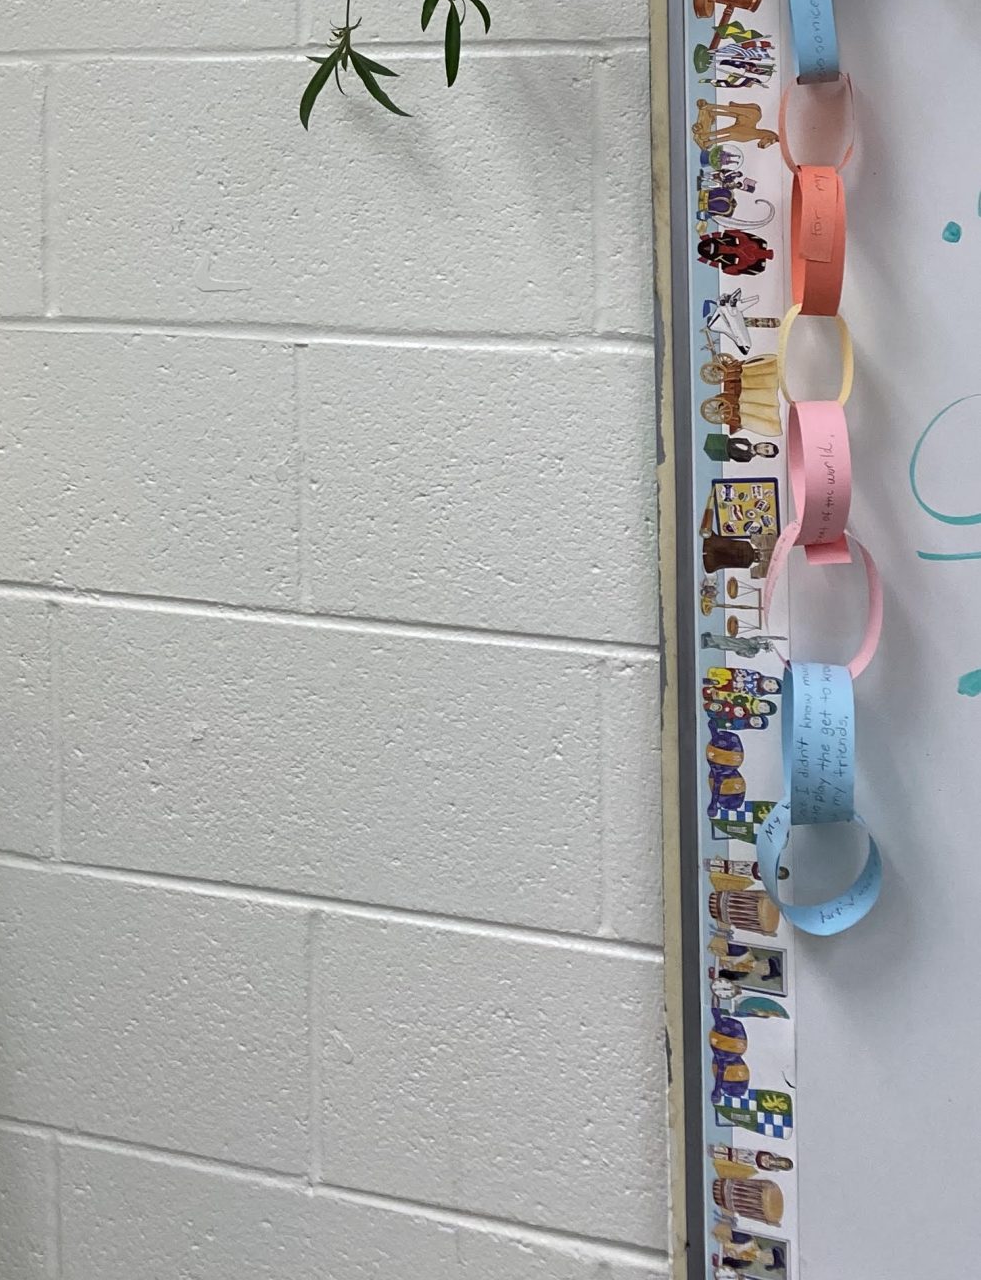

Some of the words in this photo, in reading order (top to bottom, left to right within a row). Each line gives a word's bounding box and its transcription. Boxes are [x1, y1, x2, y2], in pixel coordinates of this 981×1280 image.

[800, 693, 812, 729] know
[818, 709, 835, 737] get
[797, 737, 810, 778] didn't
[817, 744, 831, 771] the
[795, 786, 810, 795] I
[814, 778, 831, 803] play
[764, 817, 781, 843] My
